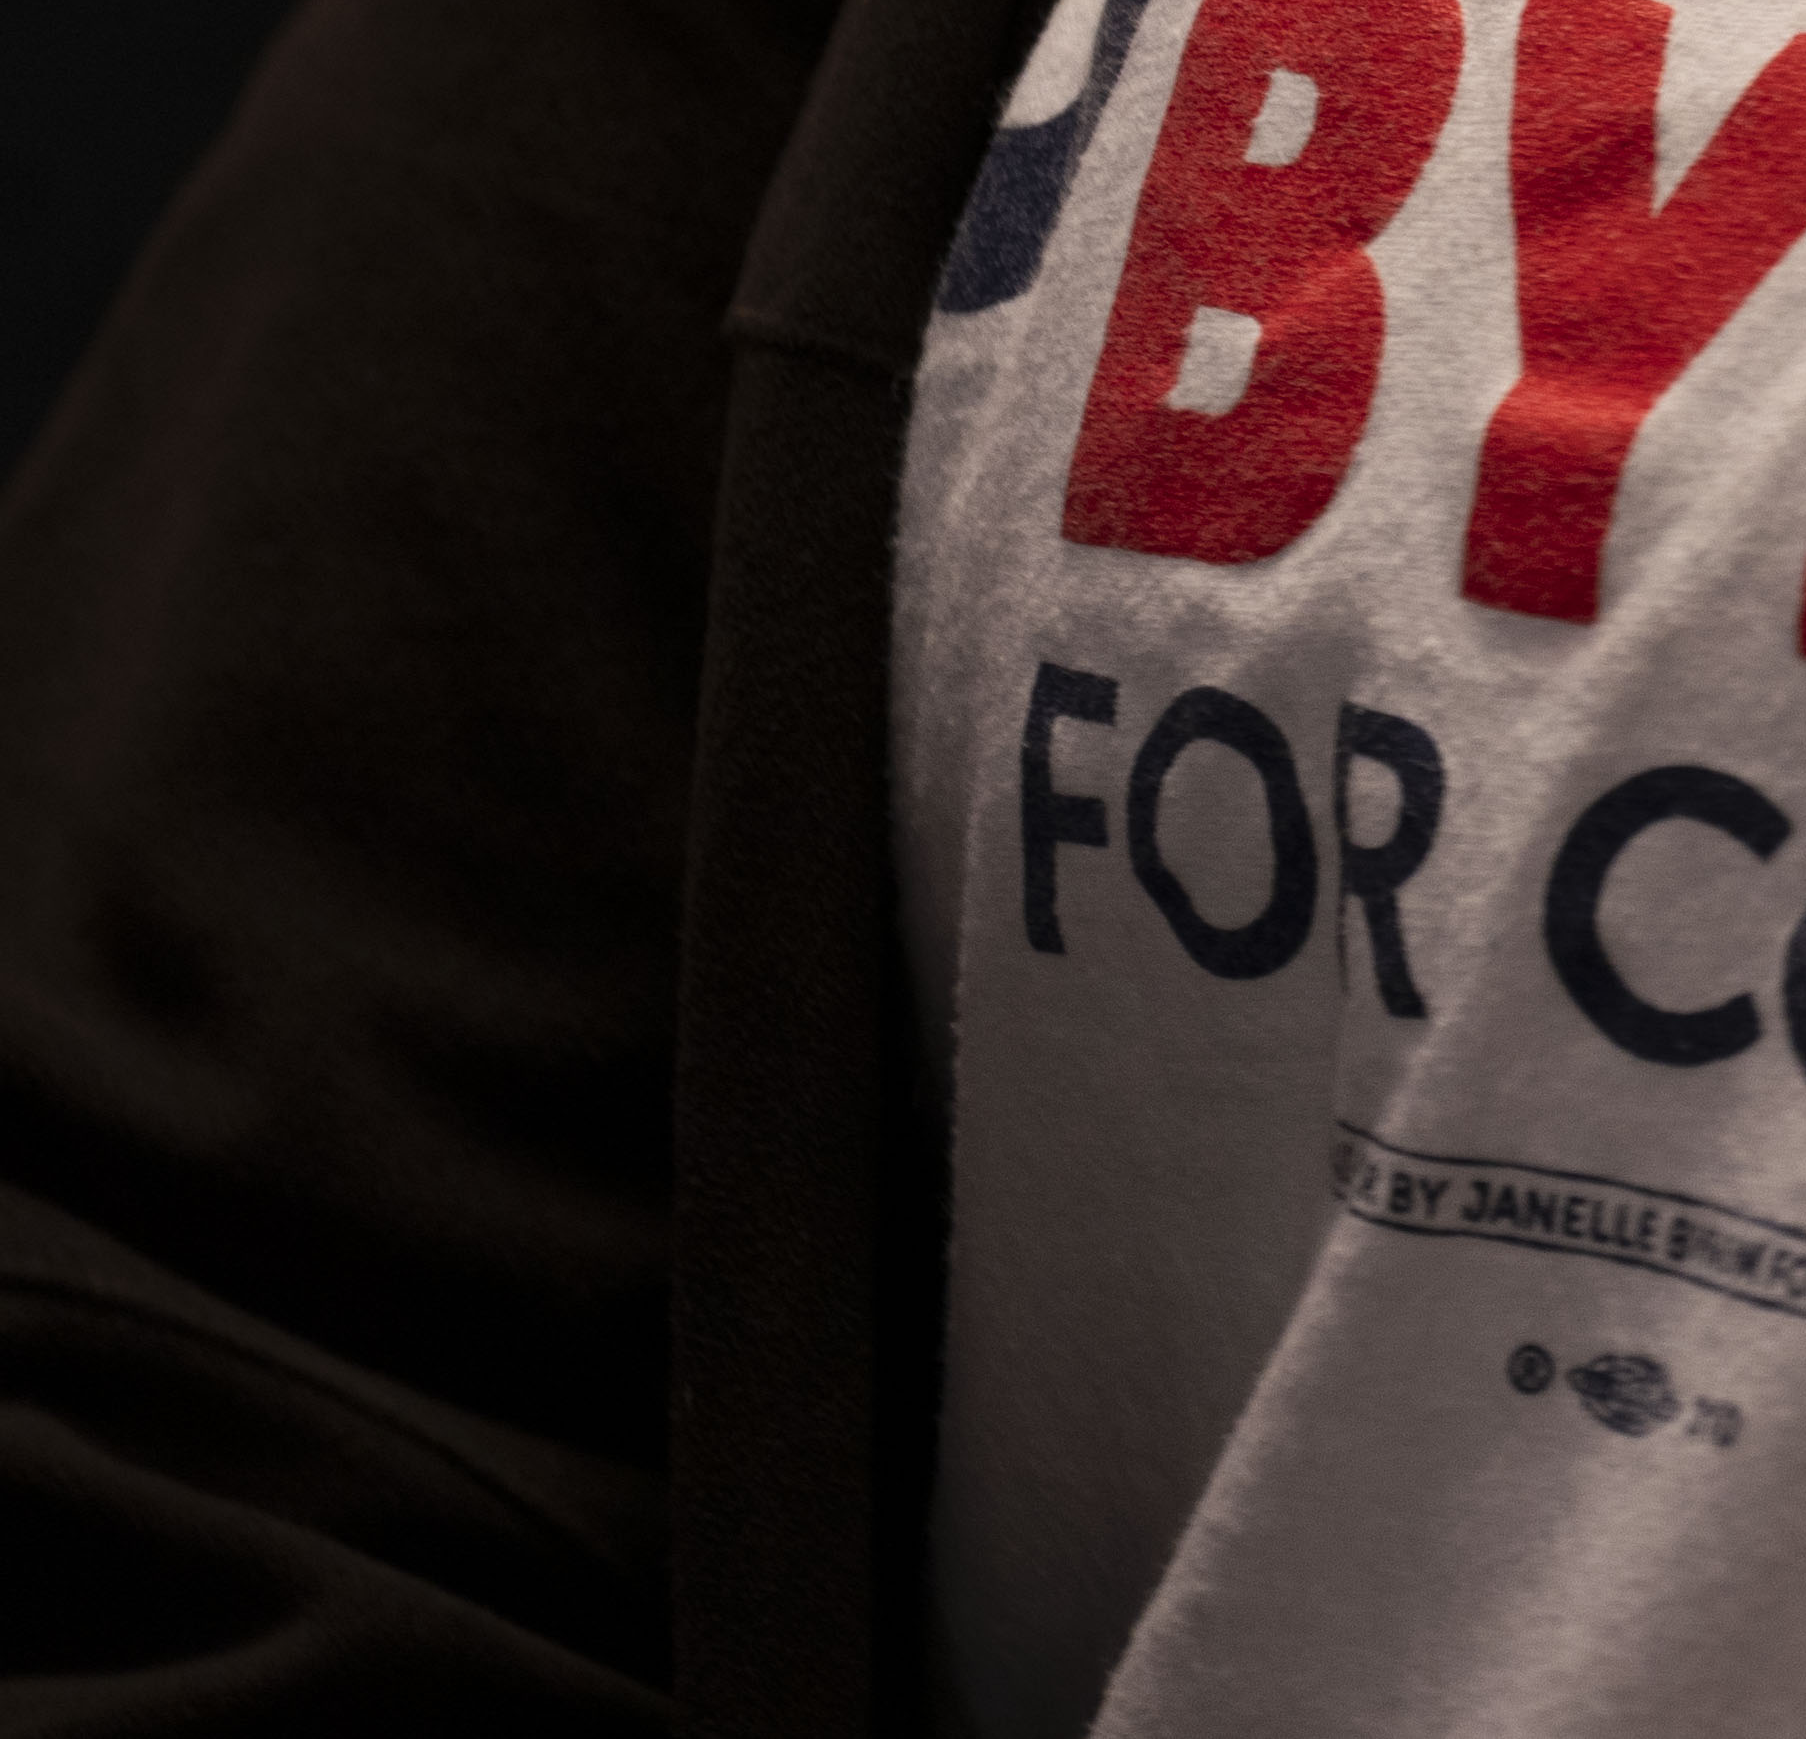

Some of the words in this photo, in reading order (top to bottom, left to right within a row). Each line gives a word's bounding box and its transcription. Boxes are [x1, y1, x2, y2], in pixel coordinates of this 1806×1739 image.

[1020, 660, 1446, 1020] FOR
[1387, 1169, 1450, 1218] BY
[1460, 1181, 1661, 1253] JANELLE
